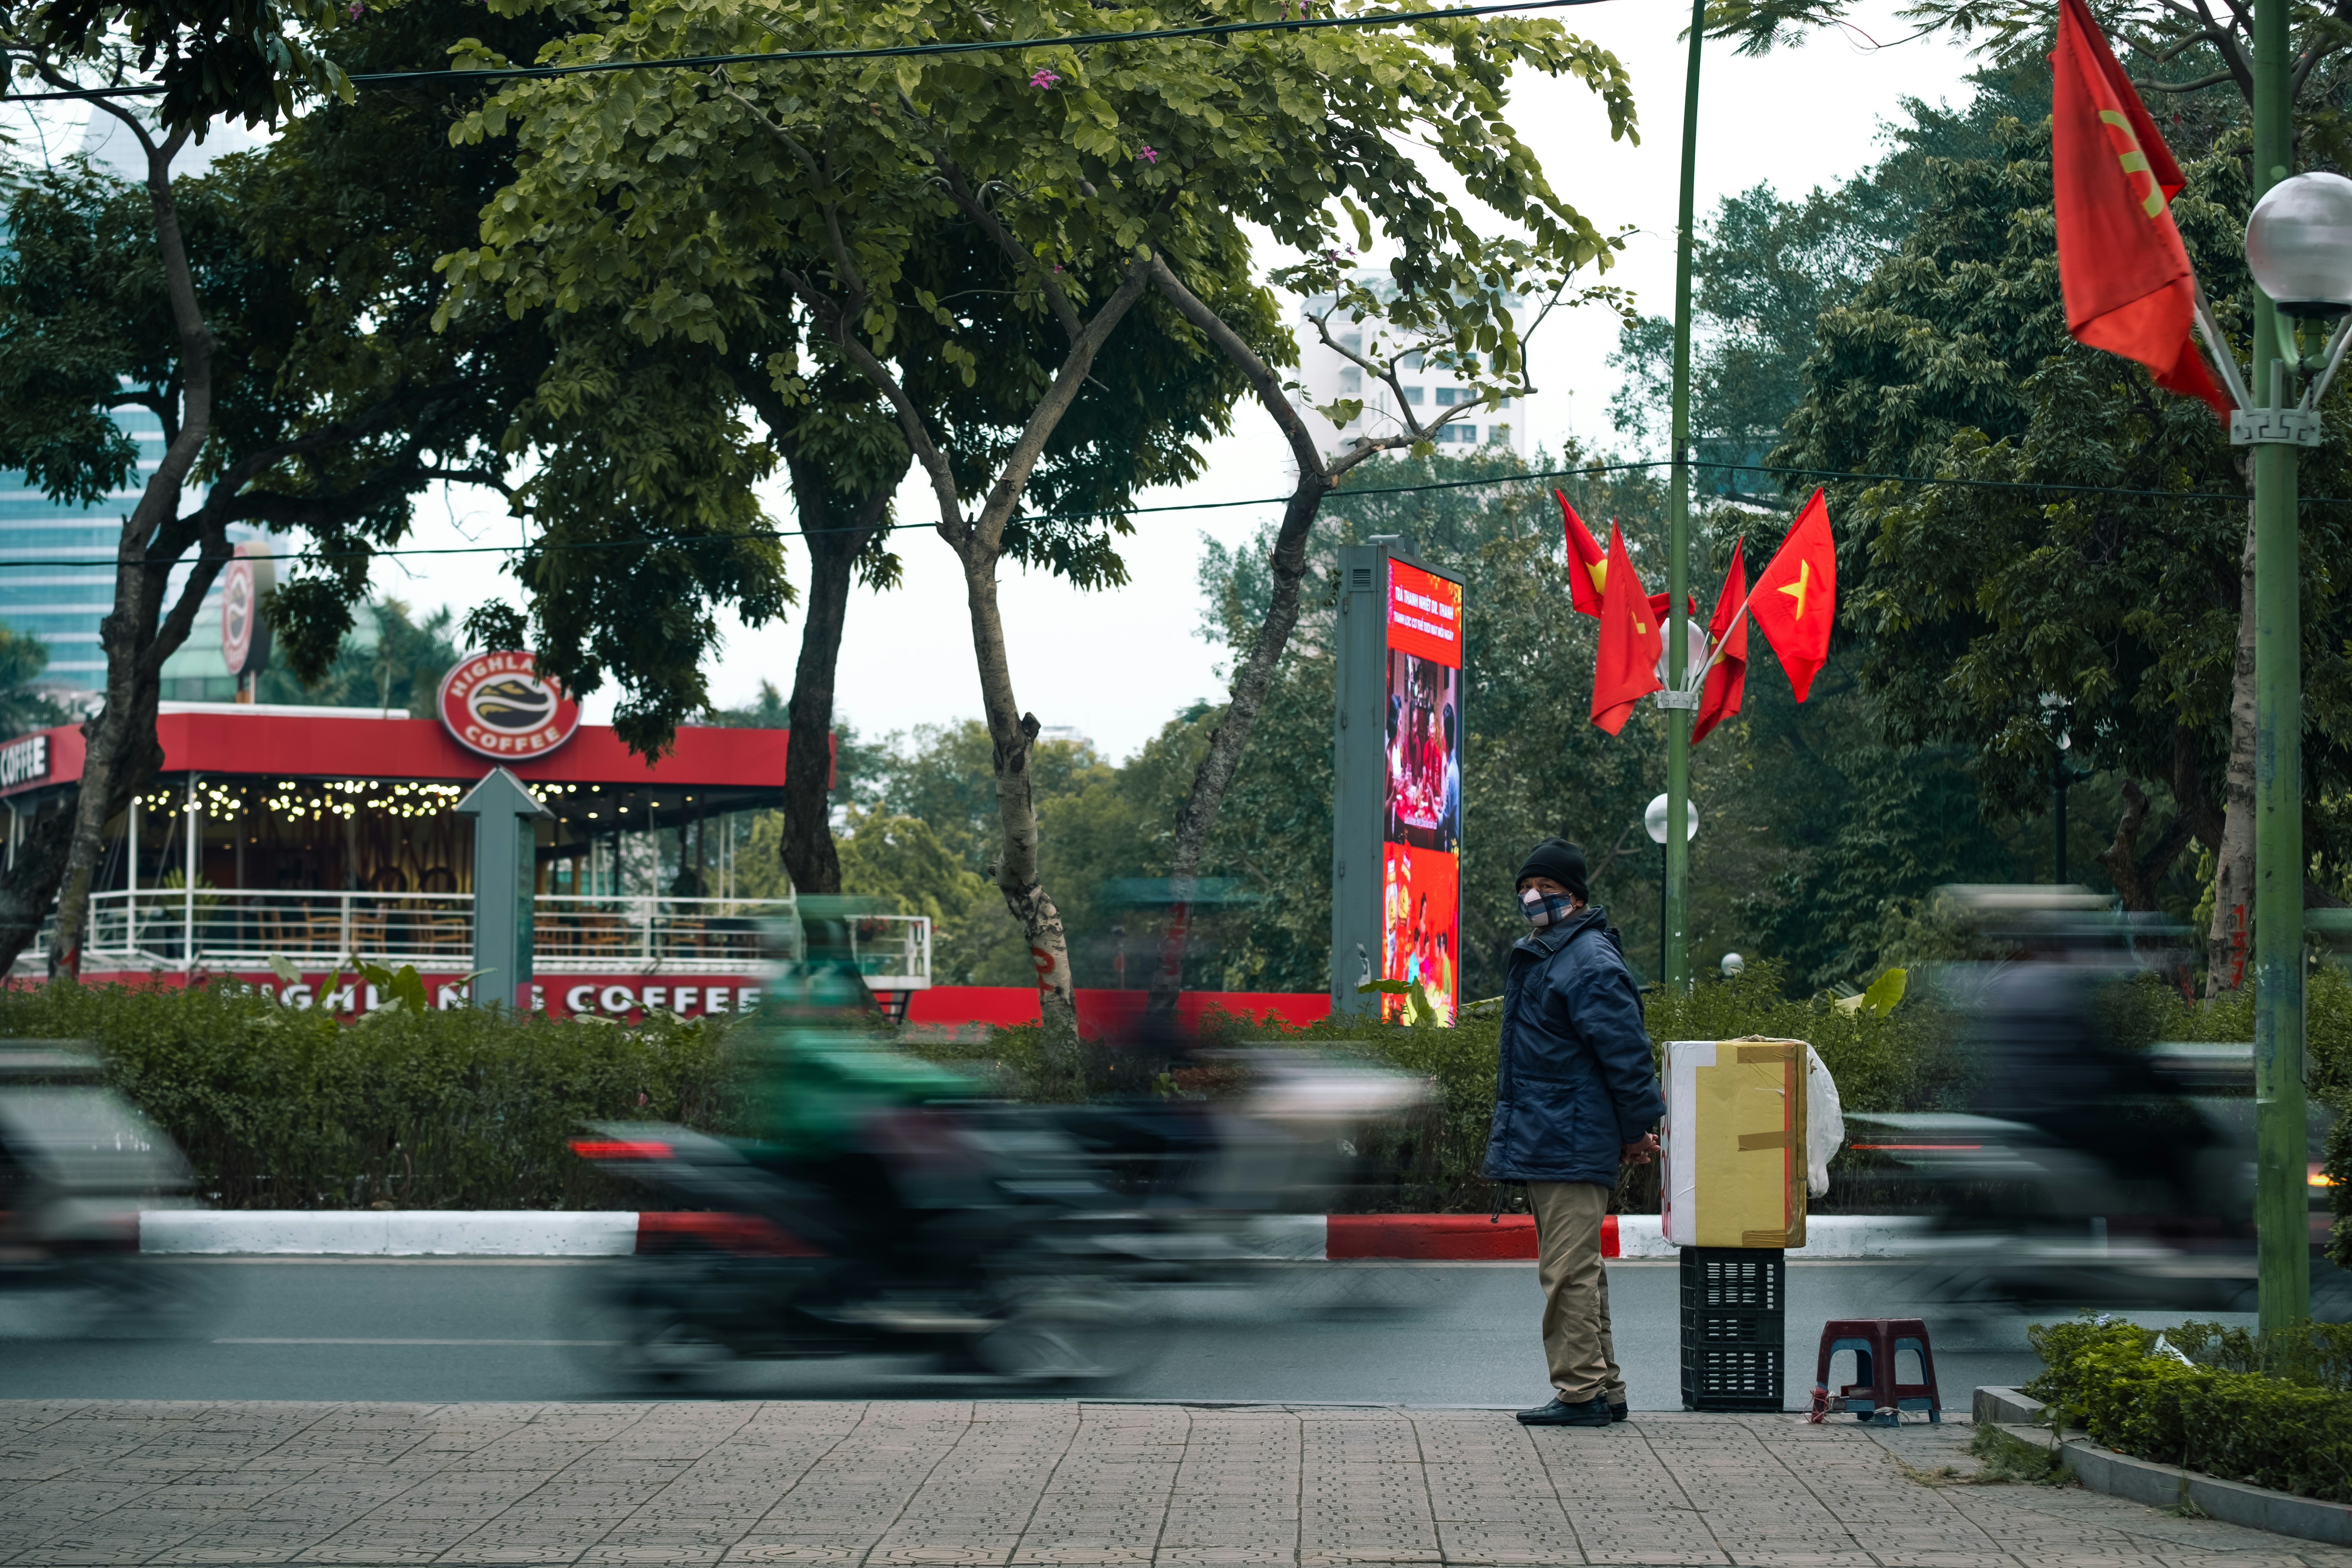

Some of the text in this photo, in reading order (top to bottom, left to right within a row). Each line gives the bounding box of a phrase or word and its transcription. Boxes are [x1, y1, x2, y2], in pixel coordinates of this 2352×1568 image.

[465, 726, 561, 752] COFFEE
[1, 736, 45, 786] COFFEE
[567, 984, 762, 1014] COFFEE
